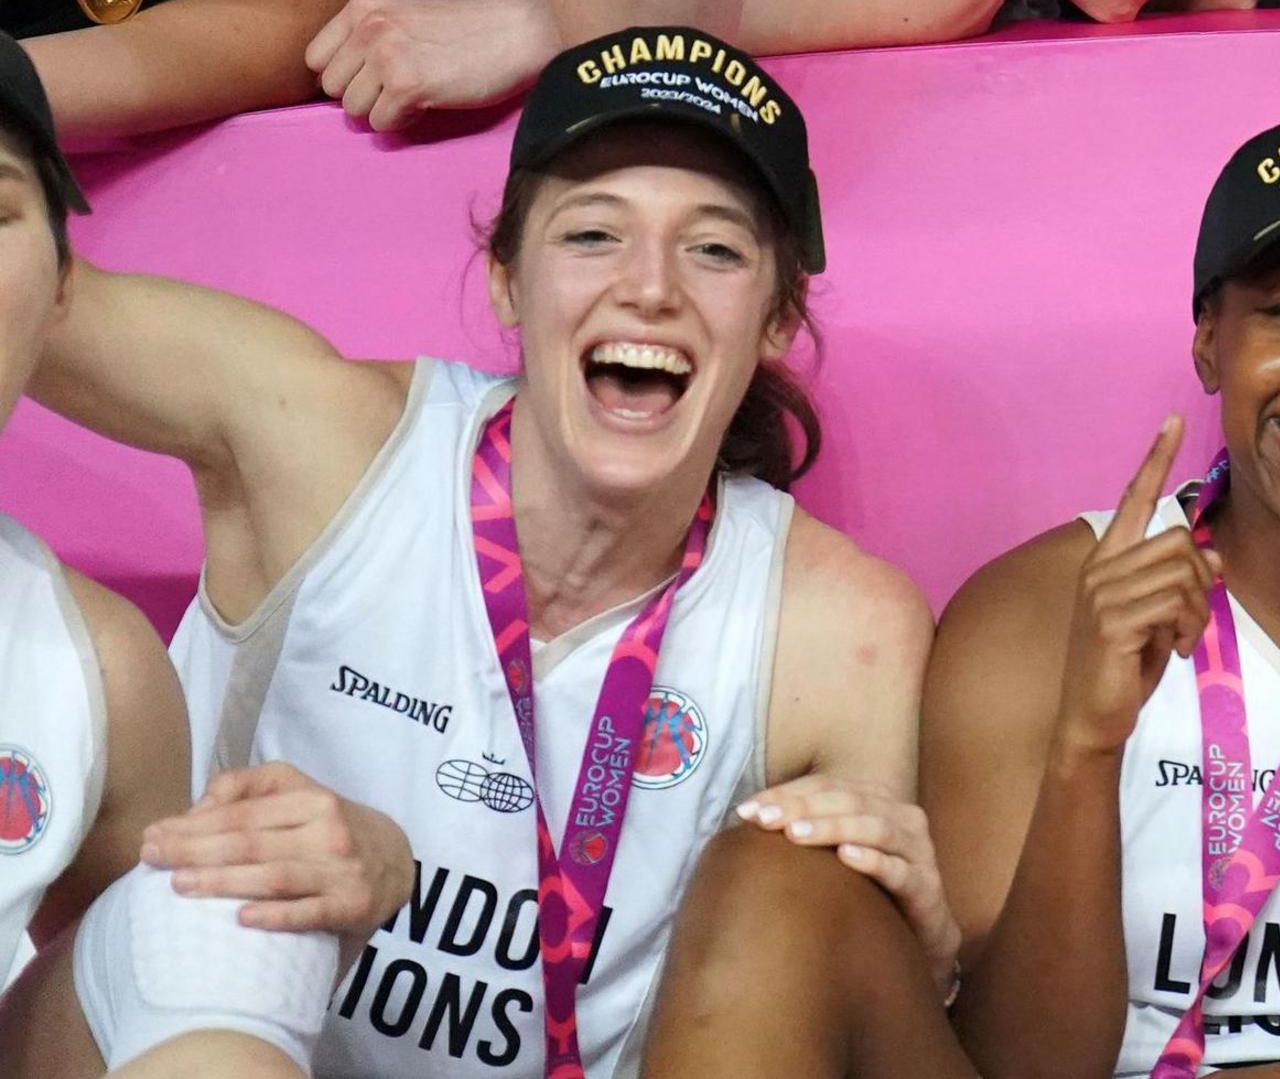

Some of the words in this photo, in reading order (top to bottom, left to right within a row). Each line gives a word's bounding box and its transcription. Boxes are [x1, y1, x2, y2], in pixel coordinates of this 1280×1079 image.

[576, 35, 781, 125] CHAMPIONS
[600, 72, 691, 88] EUROCUP
[330, 665, 453, 735] SPALDING
[576, 716, 617, 828] EUROCUP
[597, 737, 631, 828] WOMEN
[1208, 744, 1227, 855] EUROCUP
[1228, 761, 1245, 853] WOMEN
[380, 859, 613, 984] NDO
[338, 945, 533, 1067] IONS
